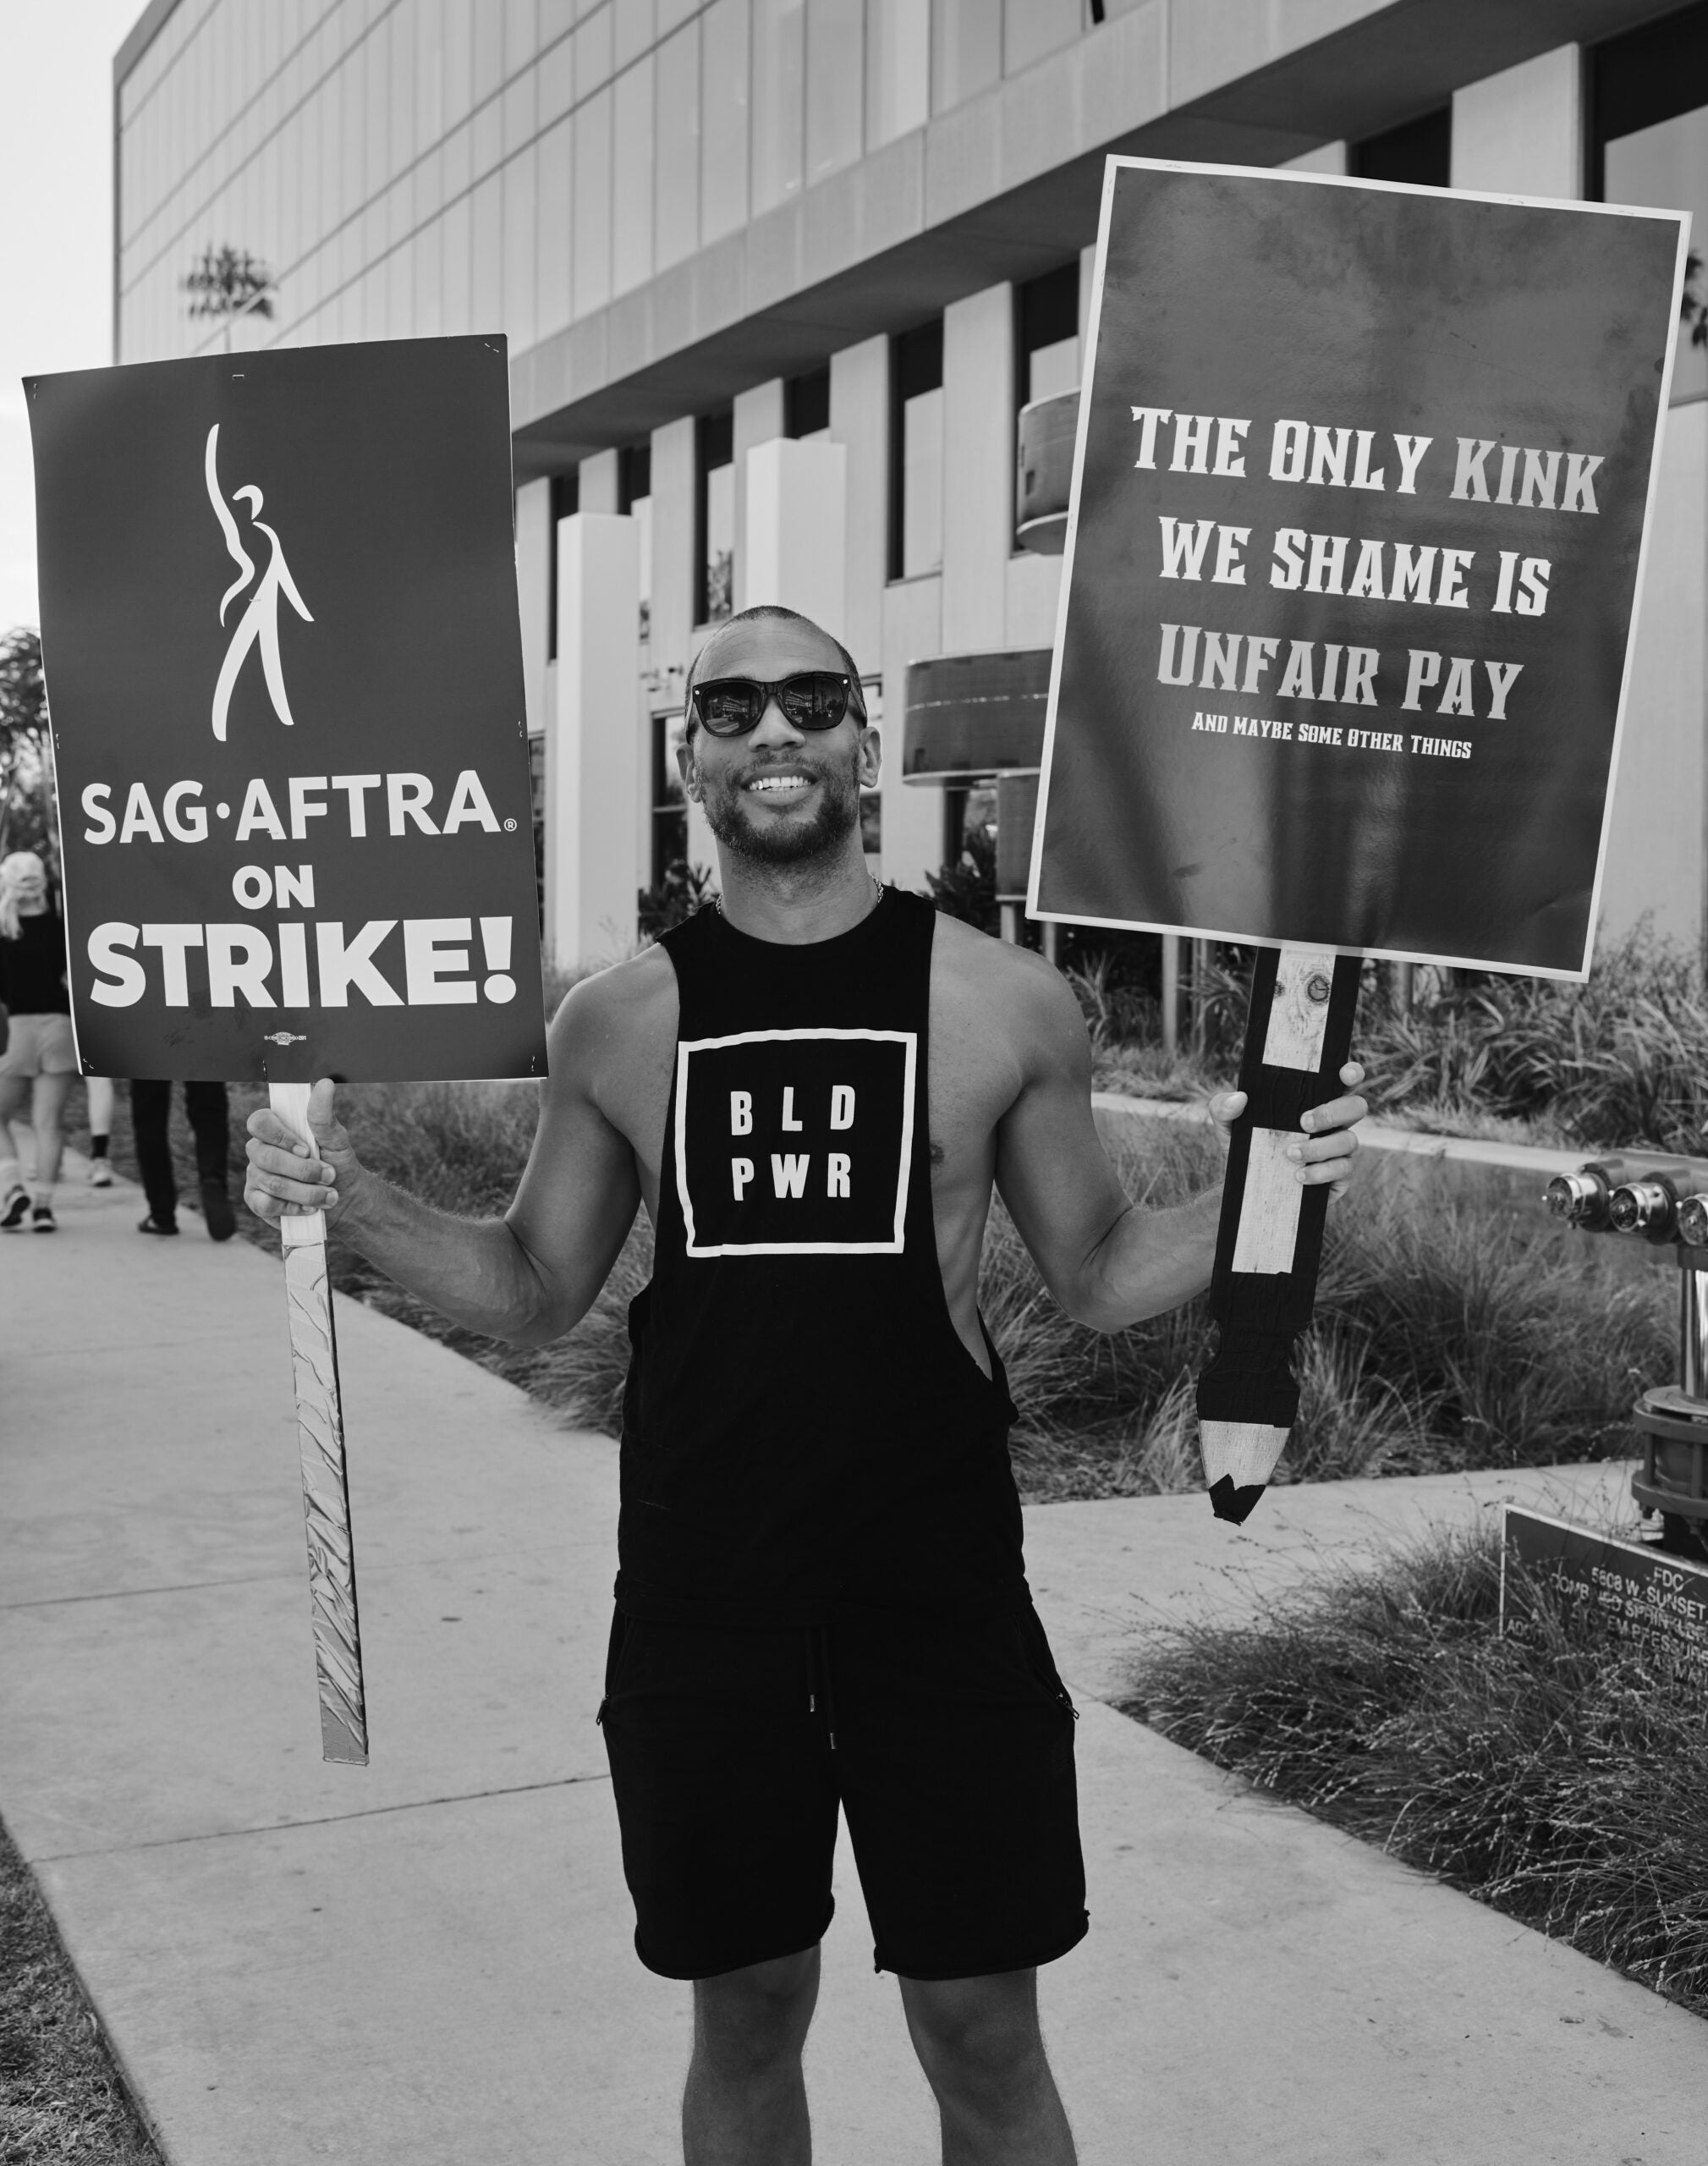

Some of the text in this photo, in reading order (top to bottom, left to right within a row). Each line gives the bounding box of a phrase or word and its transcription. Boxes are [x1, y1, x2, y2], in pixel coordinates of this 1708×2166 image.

[1130, 405, 1606, 514] THE ONLY KINK
[1157, 515, 1552, 617] WE SHAME IS
[1156, 623, 1524, 720] UNFAIR PAY
[1190, 712, 1472, 759] AND MAYBE SOME OTHER THINGS
[232, 864, 316, 910] ON
[87, 915, 517, 1008] STRIKE!
[1646, 1586, 1707, 1621] SUNSET
[1653, 1566, 1684, 1590] FDC
